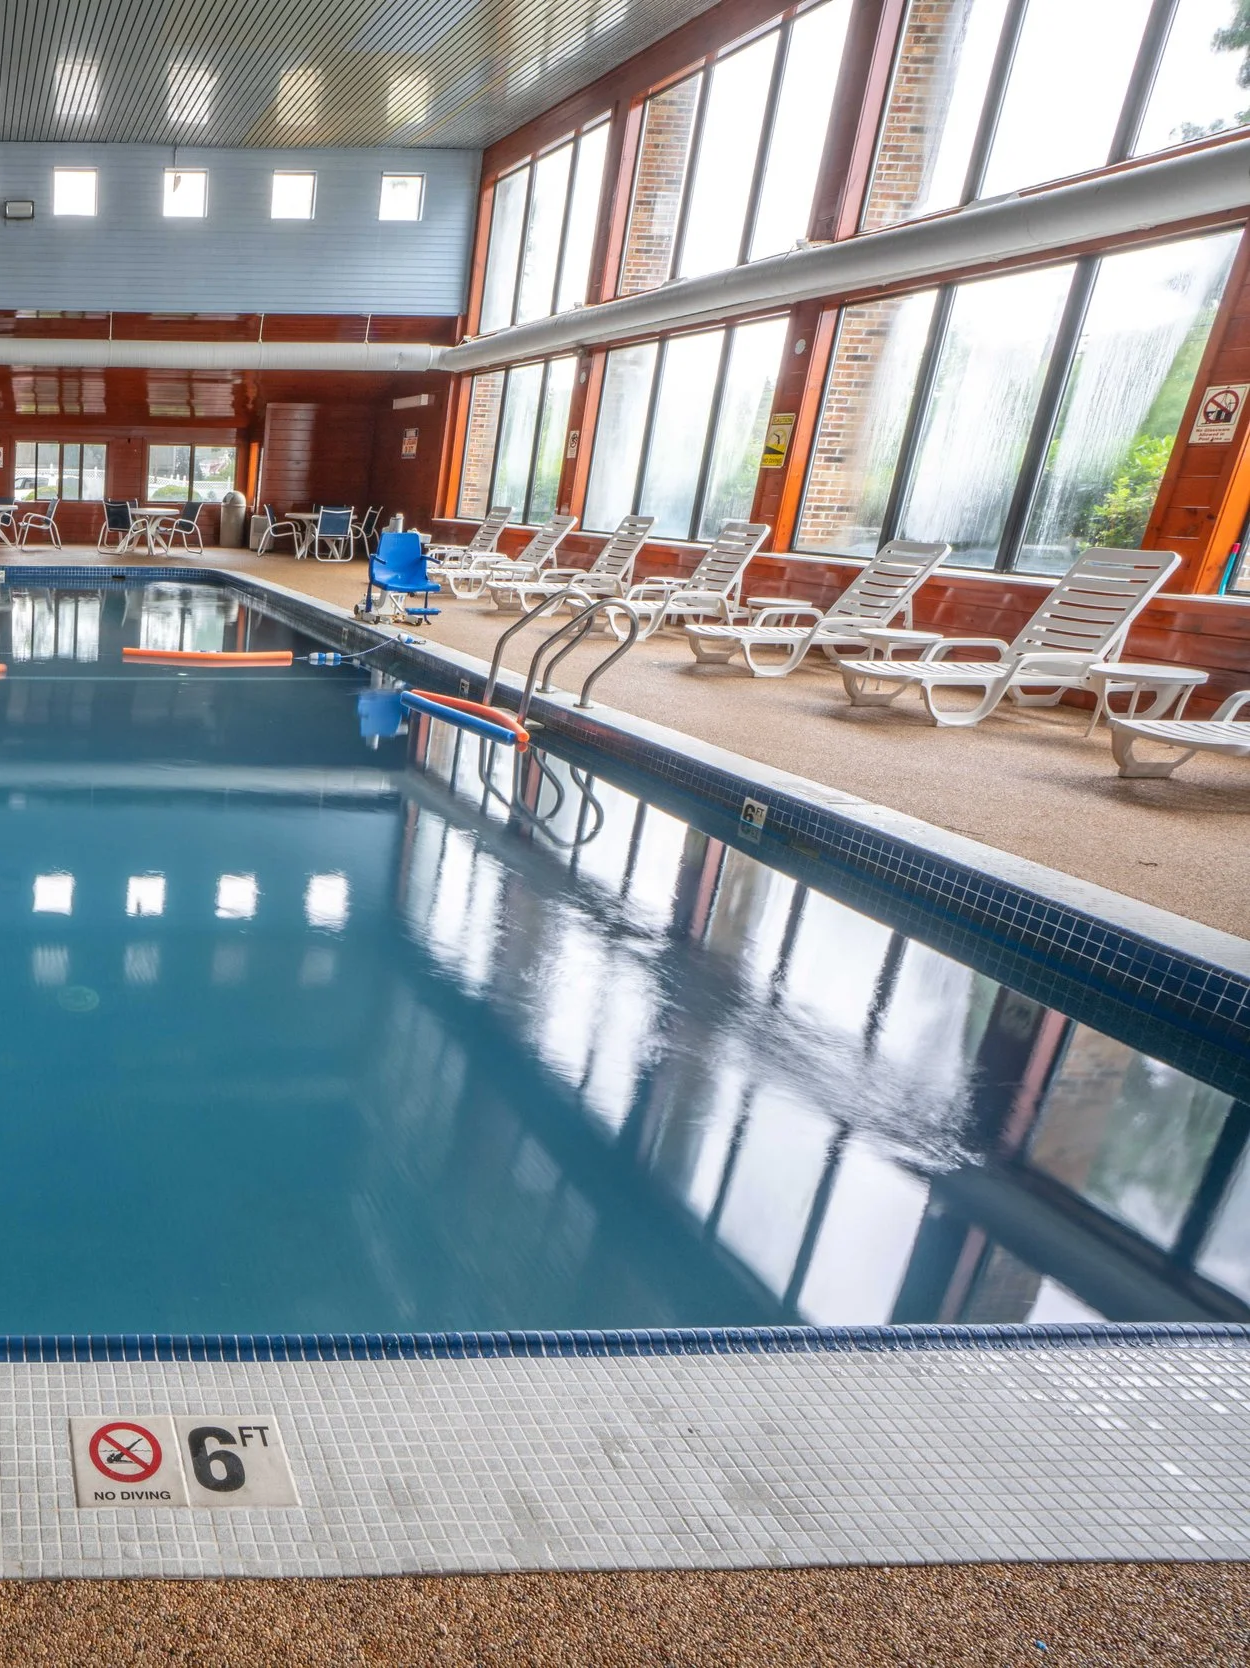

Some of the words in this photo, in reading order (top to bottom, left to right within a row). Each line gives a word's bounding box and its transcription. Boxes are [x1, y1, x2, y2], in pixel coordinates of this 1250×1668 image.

[756, 807, 765, 818] FT
[188, 1426, 245, 1492] 6
[238, 1425, 269, 1447] FT
[94, 1491, 116, 1501] NO
[120, 1490, 171, 1500] DIVING
